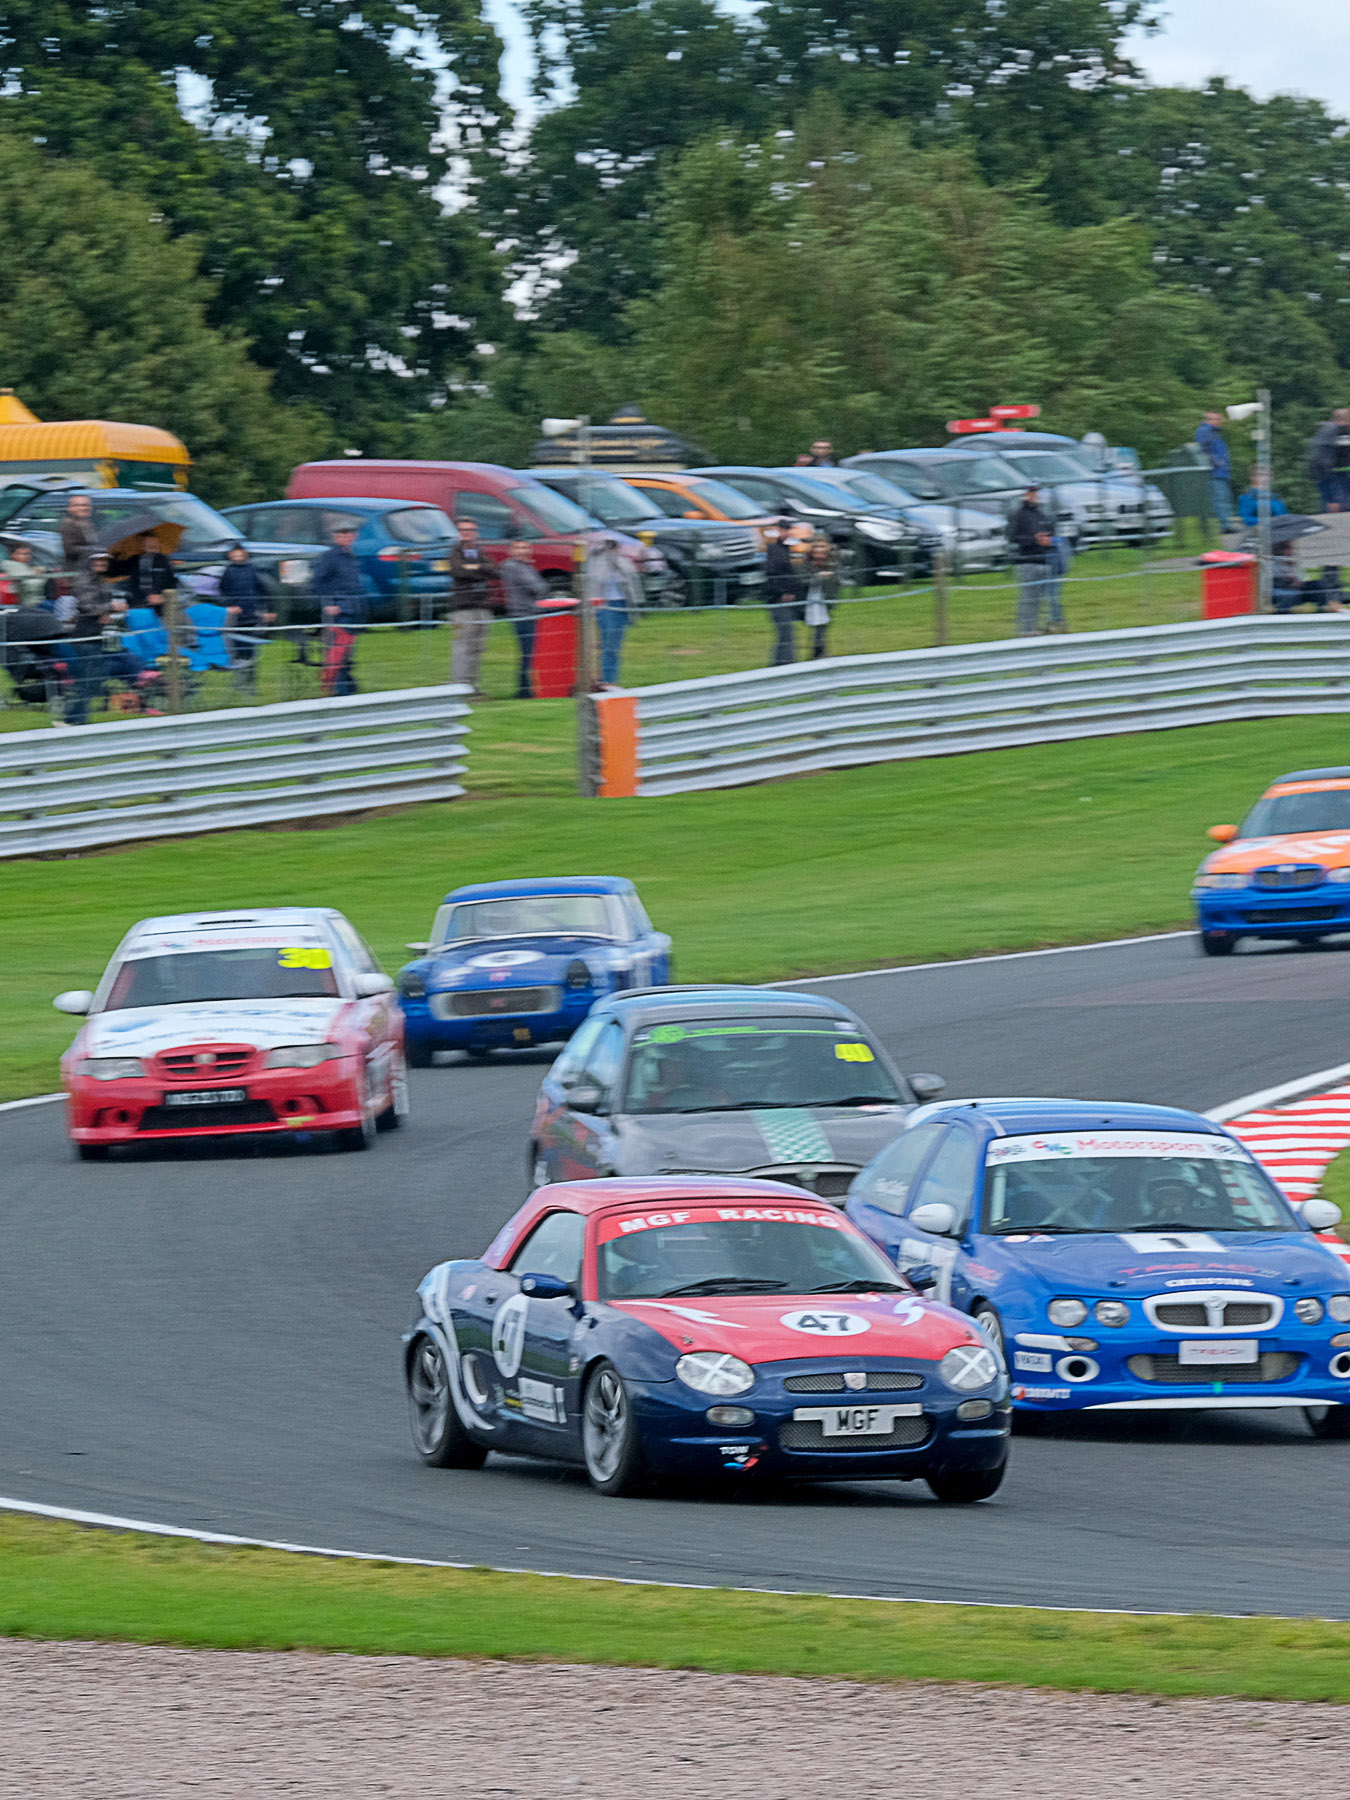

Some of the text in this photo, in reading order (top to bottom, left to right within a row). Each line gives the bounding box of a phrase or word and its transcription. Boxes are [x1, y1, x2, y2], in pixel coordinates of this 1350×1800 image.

[1076, 1138, 1205, 1152] Motorsport
[618, 1209, 841, 1233] MGF RACING
[1159, 1237, 1189, 1249] 1
[797, 1313, 852, 1332] 47
[836, 1408, 879, 1431] MGF
